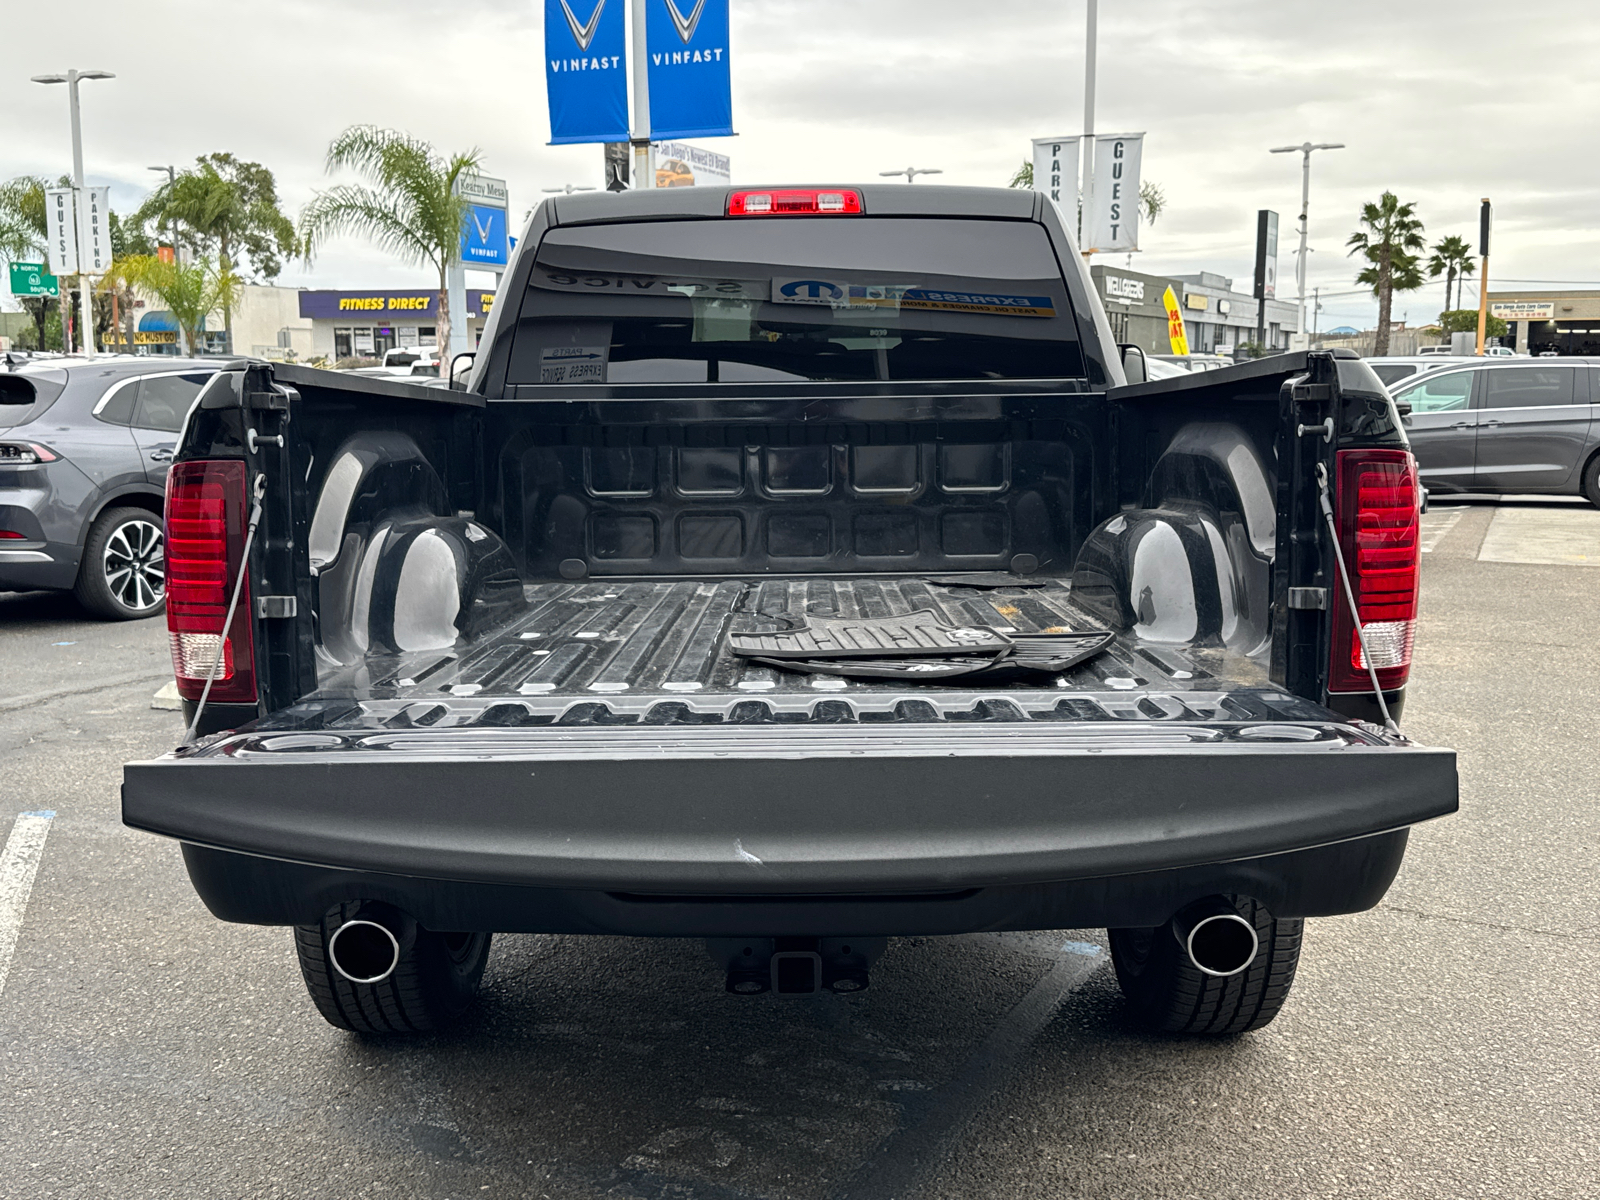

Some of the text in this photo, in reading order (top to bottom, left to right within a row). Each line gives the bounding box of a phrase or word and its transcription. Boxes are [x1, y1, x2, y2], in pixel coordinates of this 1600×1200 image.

[551, 56, 620, 73] VINFAST
[652, 48, 723, 66] VINFAST
[1051, 144, 1061, 202] PARK
[460, 179, 505, 198] Kearny Mesa
[1110, 141, 1124, 241] GUEST
[57, 195, 66, 267] GUEST
[91, 193, 101, 268] PARKING
[470, 247, 498, 258] VINFAST
[339, 297, 430, 311] FITNESS DIRECT
[145, 332, 163, 342] MUST
[164, 332, 174, 342] GO
